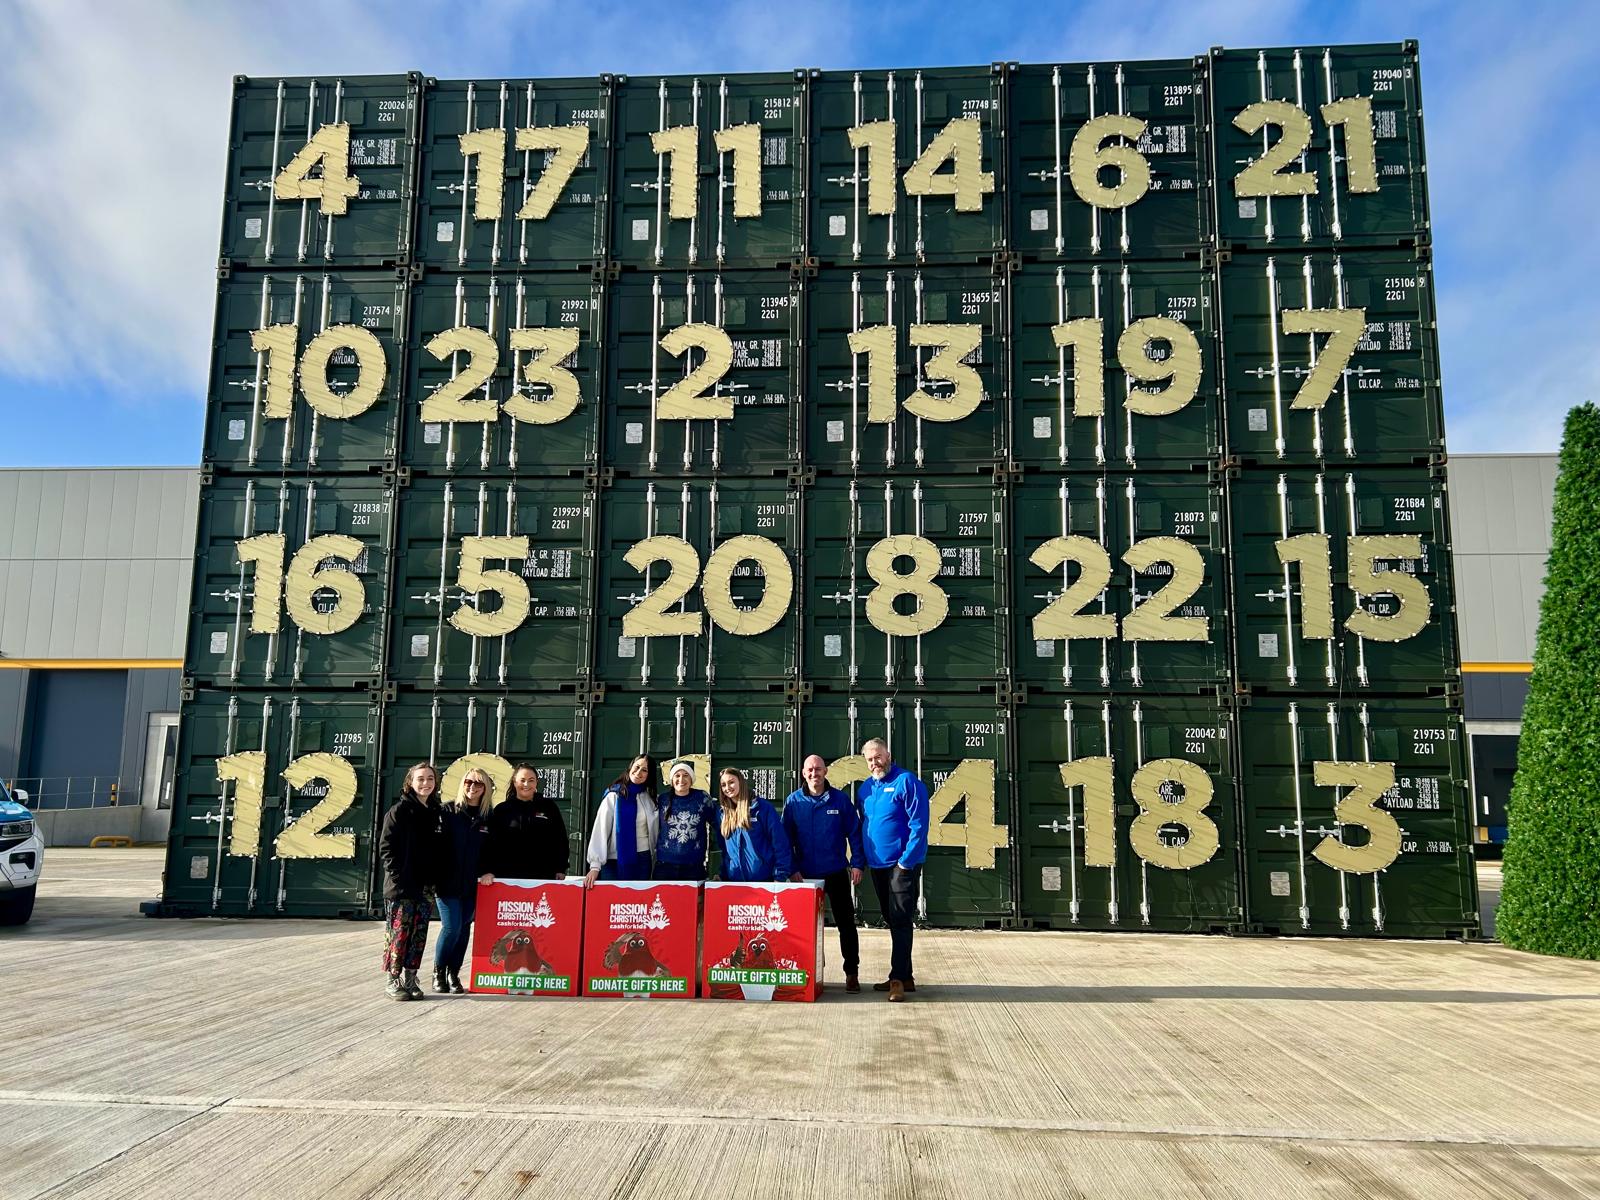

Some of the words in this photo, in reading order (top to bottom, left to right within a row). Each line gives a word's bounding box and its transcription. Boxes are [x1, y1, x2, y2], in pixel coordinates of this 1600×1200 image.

[1372, 69, 1402, 79] 219040
[1164, 85, 1192, 95] 213895
[1373, 82, 1393, 91] 22G1
[379, 101, 405, 110] 220026
[764, 98, 791, 108] 215812
[962, 100, 989, 109] 217748
[1164, 97, 1183, 106] 22G1
[378, 113, 395, 121] 22G1
[571, 110, 598, 119] 216828
[764, 109, 782, 118] 22G1
[1233, 96, 1379, 196] 21
[351, 147, 366, 156] TARE
[350, 156, 374, 165] PAYLOAD
[847, 118, 994, 213] 14
[1070, 114, 1151, 209] 6
[274, 123, 359, 215] 4
[458, 127, 590, 220] 17
[650, 125, 763, 219] 11
[1385, 278, 1415, 288] 215106
[962, 292, 990, 303] 213655
[1386, 290, 1406, 300] 22G1
[561, 300, 588, 310] 219921
[761, 297, 788, 307] 213945
[1167, 297, 1197, 308] 217573
[363, 306, 390, 315] 217574
[761, 310, 779, 319] 22G1
[962, 305, 980, 315] 22G1
[1168, 310, 1187, 319] 22G1
[362, 317, 380, 327] 22G1
[560, 313, 578, 322] 22G1
[1368, 323, 1385, 332] GROSS
[733, 350, 748, 358] TARE
[1282, 307, 1366, 411] 7
[331, 355, 355, 364] PAYLOAD
[732, 358, 759, 367] PAYLOAD
[249, 323, 387, 419] 10
[655, 323, 734, 420] 2
[1051, 316, 1203, 417] 19
[420, 326, 580, 424] 23
[846, 324, 984, 423] 13
[353, 503, 380, 513] 218838
[1394, 498, 1425, 508] 221684
[553, 507, 581, 517] 219929
[757, 505, 785, 514] 219110
[352, 516, 370, 525] 22G1
[959, 513, 988, 522] 217597
[1174, 512, 1204, 522] 218073
[1395, 511, 1415, 521] 22G1
[552, 520, 570, 529] 22G1
[757, 517, 775, 527] 22G1
[959, 526, 977, 535] 22G1
[1175, 525, 1194, 535] 22G1
[941, 548, 957, 557] GROSS
[523, 559, 538, 568] TARE
[521, 568, 548, 577] PAYLOAD
[236, 534, 366, 636] 16
[449, 536, 531, 637] 5
[622, 535, 794, 637] 20
[866, 535, 949, 637] 8
[1031, 535, 1209, 642] 22
[1274, 533, 1432, 641] 15
[534, 607, 549, 616] CAP.
[753, 721, 782, 732] 214570
[965, 723, 993, 734] 219021
[334, 733, 362, 743] 217985
[543, 732, 572, 742] 216942
[1185, 728, 1216, 739] 220042
[1413, 729, 1445, 740] 219753
[753, 734, 772, 744] 22G1
[965, 736, 984, 747] 22G1
[543, 745, 561, 754] 22G1
[1185, 742, 1205, 753] 22G1
[1413, 743, 1434, 754] 22G1
[301, 786, 326, 797] PAYLOAD
[1161, 785, 1174, 795] ARE
[215, 751, 358, 859] 12
[1060, 756, 1220, 869] 18
[1313, 761, 1402, 875] 3
[1402, 842, 1419, 852] CAP.
[498, 901, 534, 912] MISSION
[610, 903, 647, 915] MISSION
[728, 904, 765, 916] MISSION
[497, 912, 534, 921] CHRISTMAS
[610, 914, 647, 923] CHRISTMAS
[728, 915, 766, 925] CHRISTMAS
[478, 974, 513, 987] DONATE
[515, 976, 542, 988] GIFTS
[544, 977, 567, 989] HERE
[711, 970, 748, 982] DONATE
[750, 971, 776, 983] GIFTS
[779, 972, 803, 984] HERE
[592, 979, 628, 990] DONATE
[631, 980, 658, 990] GIFTS
[660, 980, 685, 991] HERE
